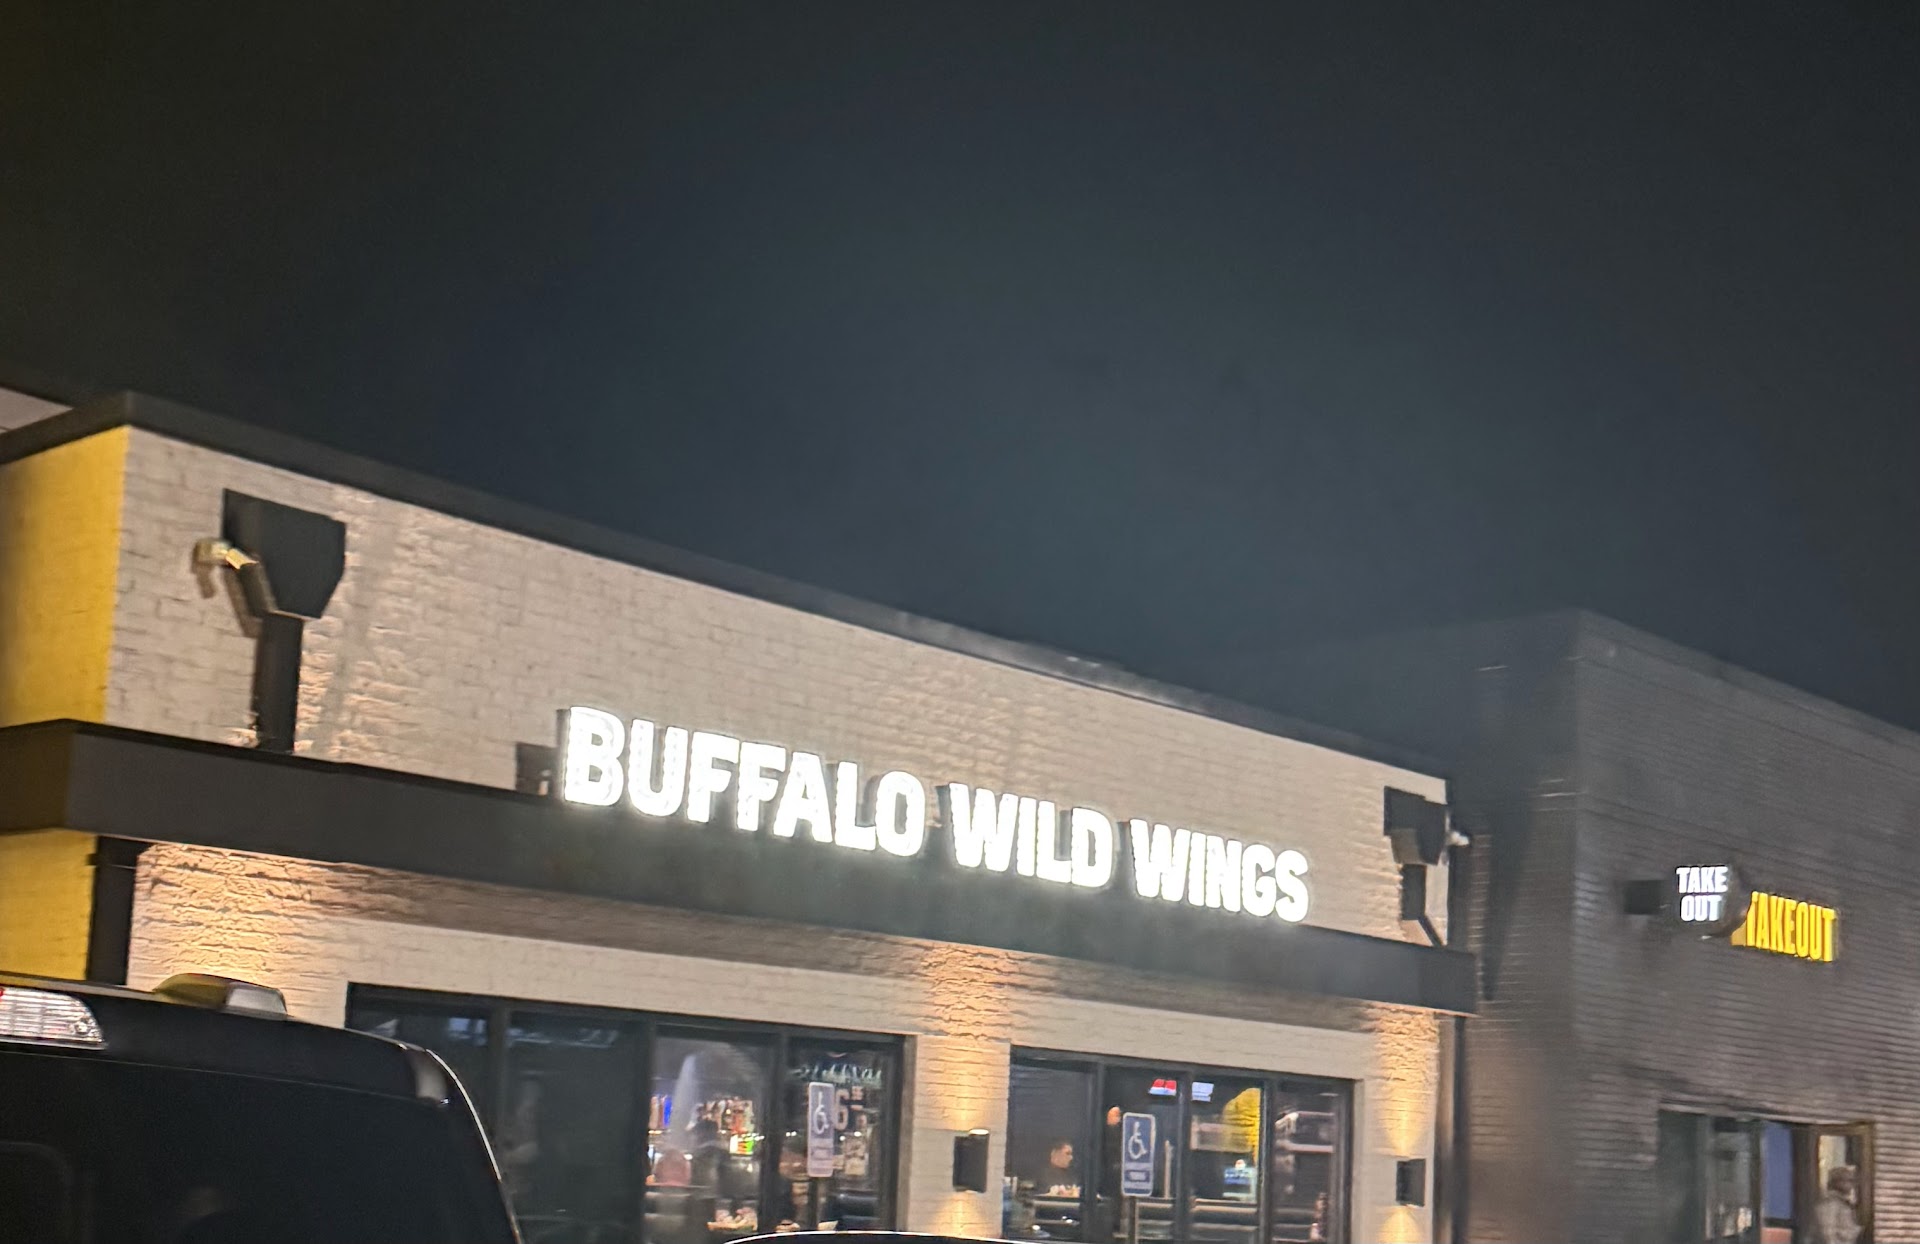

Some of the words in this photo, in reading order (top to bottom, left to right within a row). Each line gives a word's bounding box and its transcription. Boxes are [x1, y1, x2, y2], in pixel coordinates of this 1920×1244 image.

[564, 706, 926, 857] BUFFALO
[949, 784, 1113, 888] WILD
[1131, 821, 1309, 922] WINGS
[1676, 867, 1728, 893] TAKE
[1681, 895, 1722, 921] OUT
